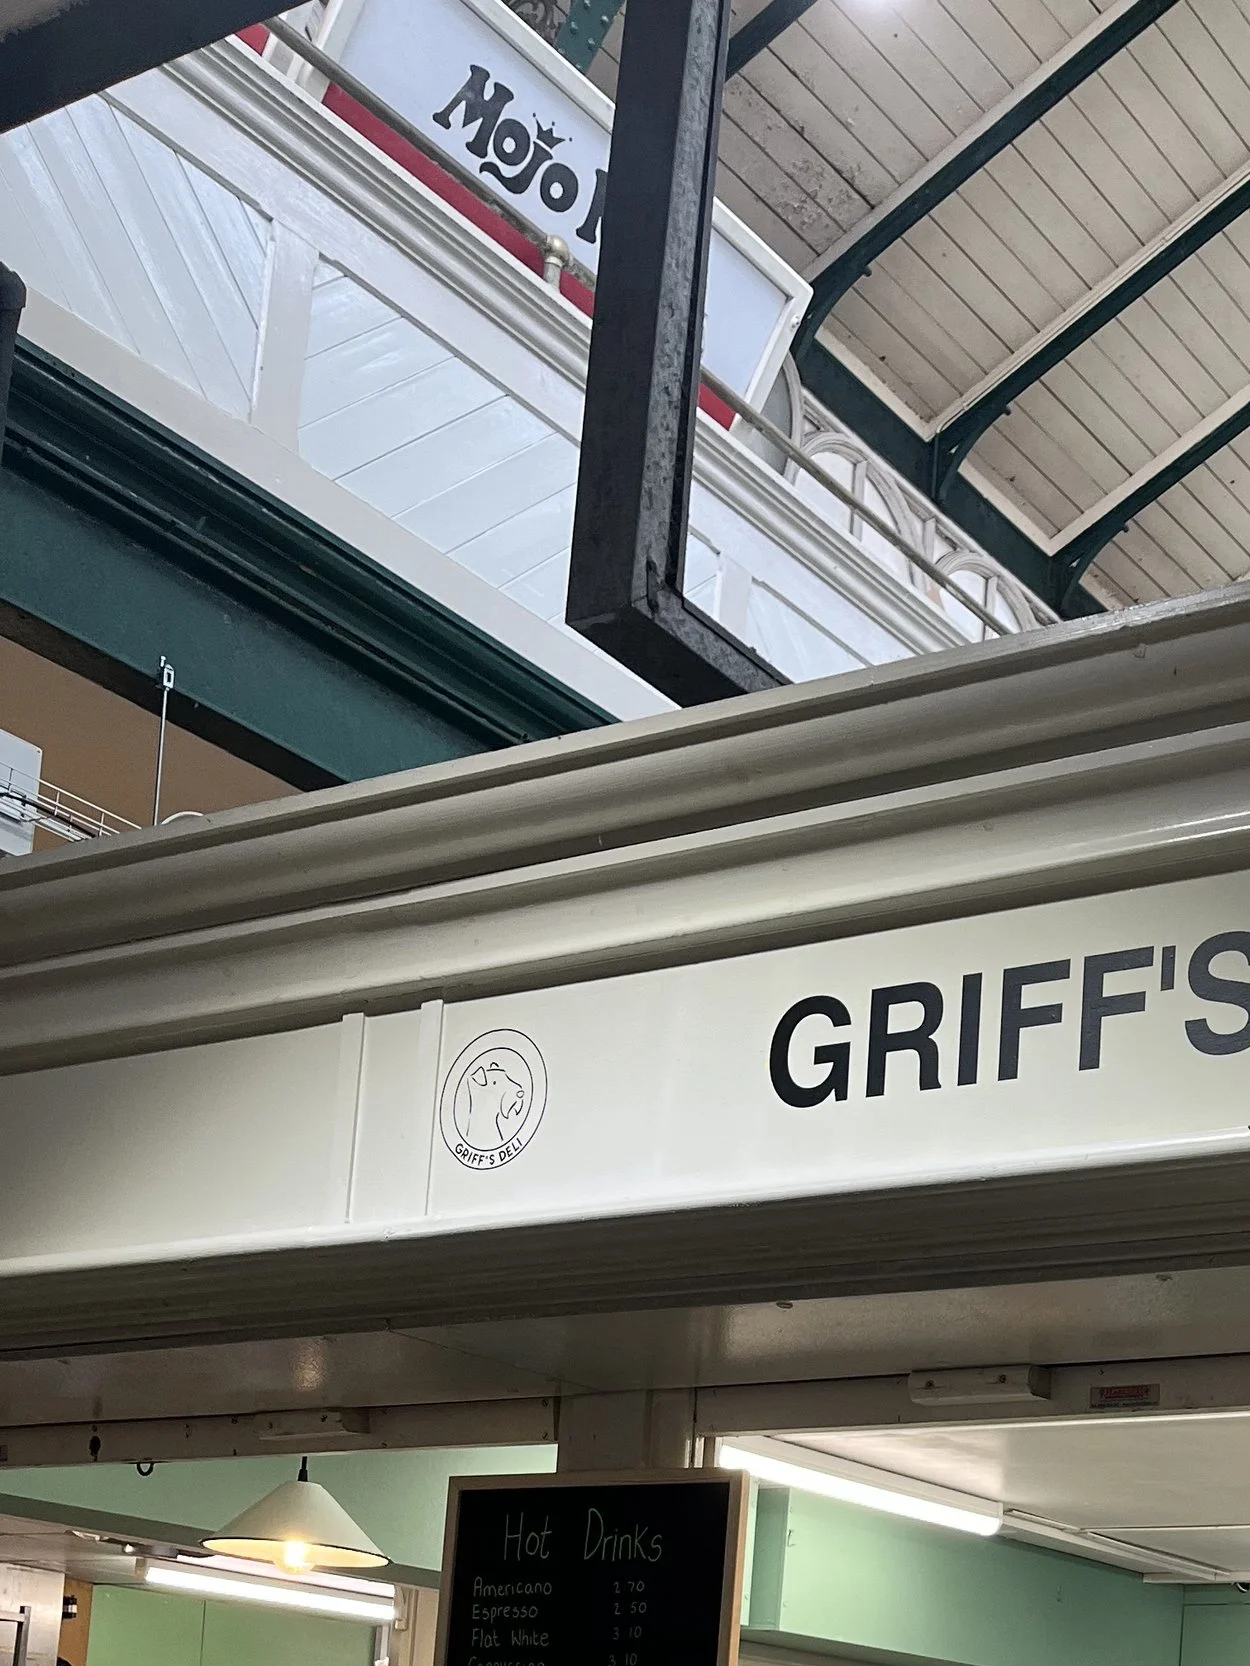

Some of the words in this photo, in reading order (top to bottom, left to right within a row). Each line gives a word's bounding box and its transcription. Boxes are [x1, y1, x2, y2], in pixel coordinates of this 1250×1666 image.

[455, 1143, 495, 1166] GRIFF'S
[499, 1138, 523, 1162] DELI
[503, 1512, 552, 1561] Hot
[584, 1508, 662, 1561] Drinks
[473, 1576, 552, 1596] Americano
[472, 1605, 538, 1623] Espresso
[471, 1629, 500, 1648] Flat
[511, 1630, 549, 1646] White
